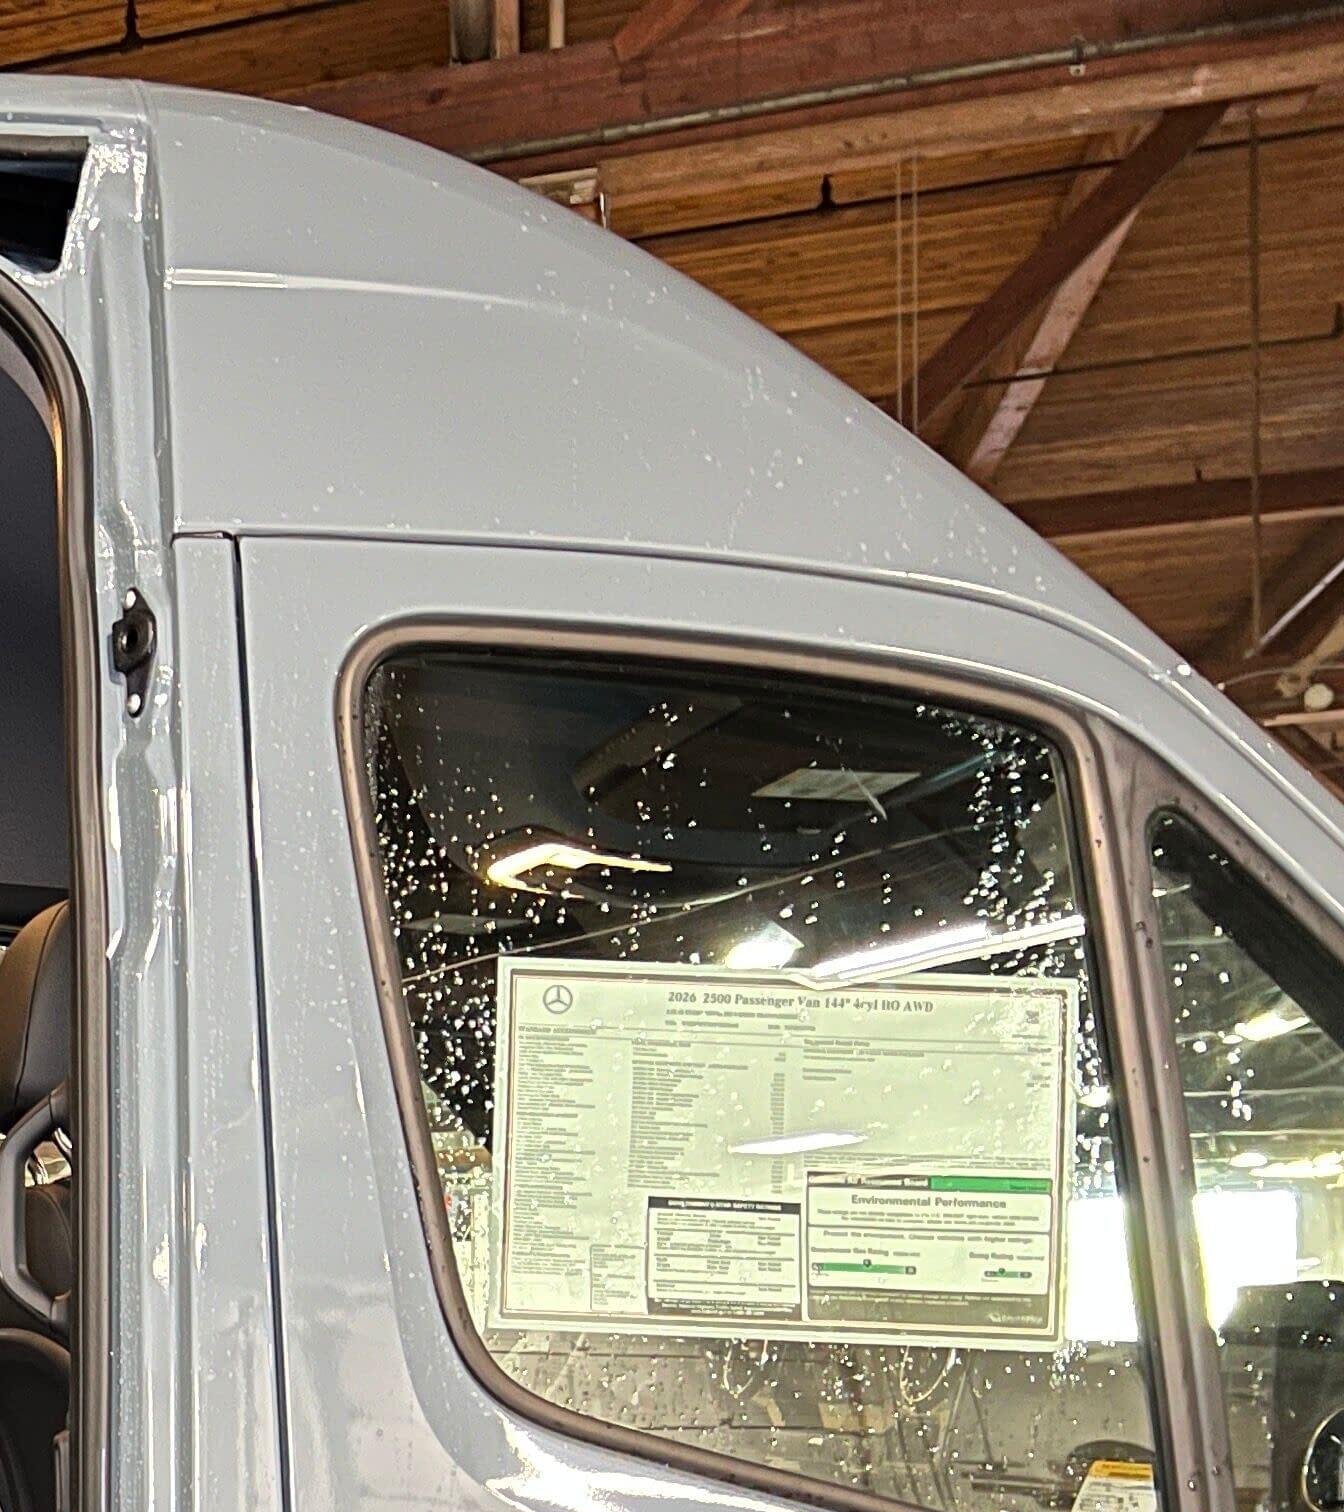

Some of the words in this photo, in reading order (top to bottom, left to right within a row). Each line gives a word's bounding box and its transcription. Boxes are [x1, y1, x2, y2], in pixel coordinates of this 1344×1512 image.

[668, 992, 697, 1003] 2026
[703, 993, 732, 1004] 2500
[735, 994, 795, 1008] Passenger
[798, 996, 821, 1008] Van
[903, 1000, 934, 1012] AWD
[851, 1194, 931, 1207] Environmental
[935, 1197, 1006, 1209] Performance
